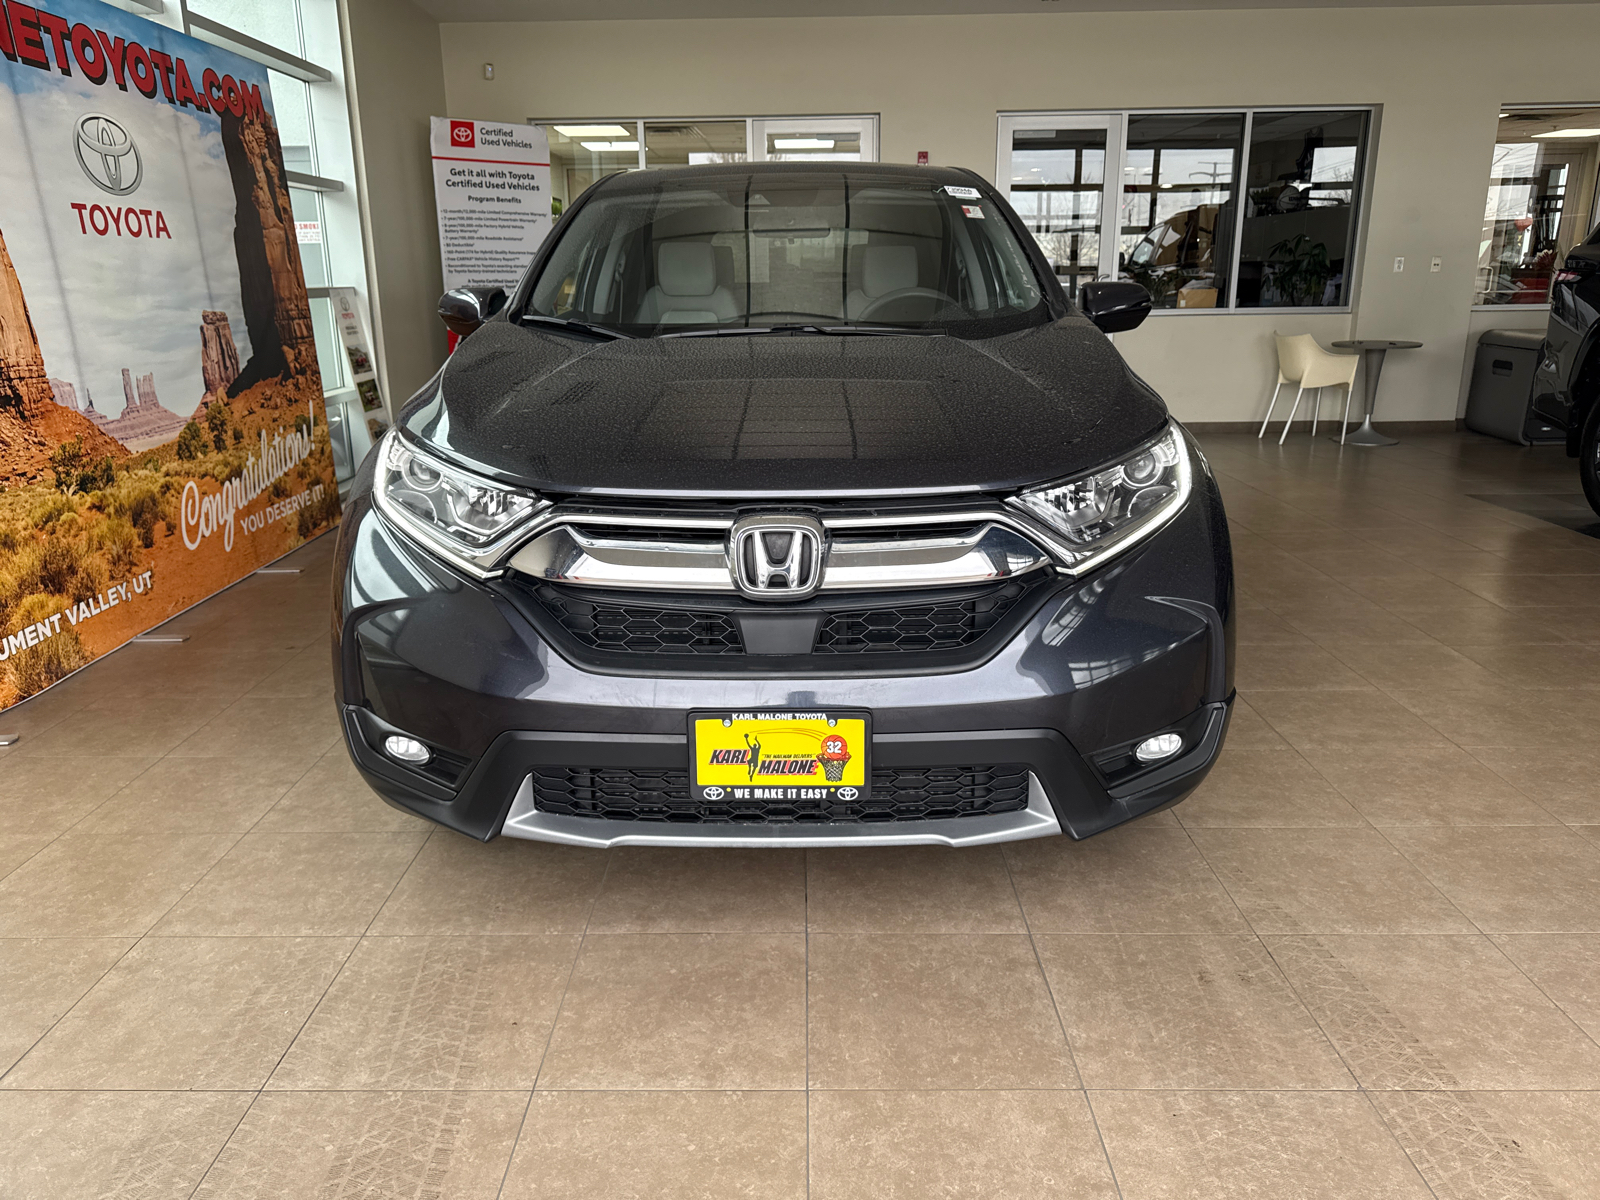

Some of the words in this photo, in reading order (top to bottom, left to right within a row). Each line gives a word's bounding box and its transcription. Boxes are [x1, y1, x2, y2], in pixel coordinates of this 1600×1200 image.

[480, 127, 514, 137] Certified
[480, 138, 500, 146] Used
[501, 138, 532, 149] Vehicles
[450, 168, 466, 176] Get
[468, 168, 474, 177] it
[476, 169, 486, 178] all
[488, 170, 506, 179] with
[508, 171, 535, 181] Toyota
[446, 179, 483, 188] Certified
[484, 180, 506, 189] Used
[507, 182, 540, 191] Vehicles
[468, 195, 495, 203] Program
[70, 202, 172, 240] TOYOTA
[181, 400, 315, 552] Congratulations!
[240, 511, 264, 535] YOU
[266, 489, 312, 524] DESERVE
[312, 484, 326, 504] IT!
[64, 582, 132, 626] VALLEY,
[132, 571, 152, 594] UT
[826, 741, 842, 753] 32
[709, 749, 750, 765] KARL
[758, 760, 818, 775] MALONE
[734, 788, 751, 799] WE
[754, 788, 784, 799] MAKE
[788, 788, 798, 799] IT
[801, 788, 828, 799] EASY
